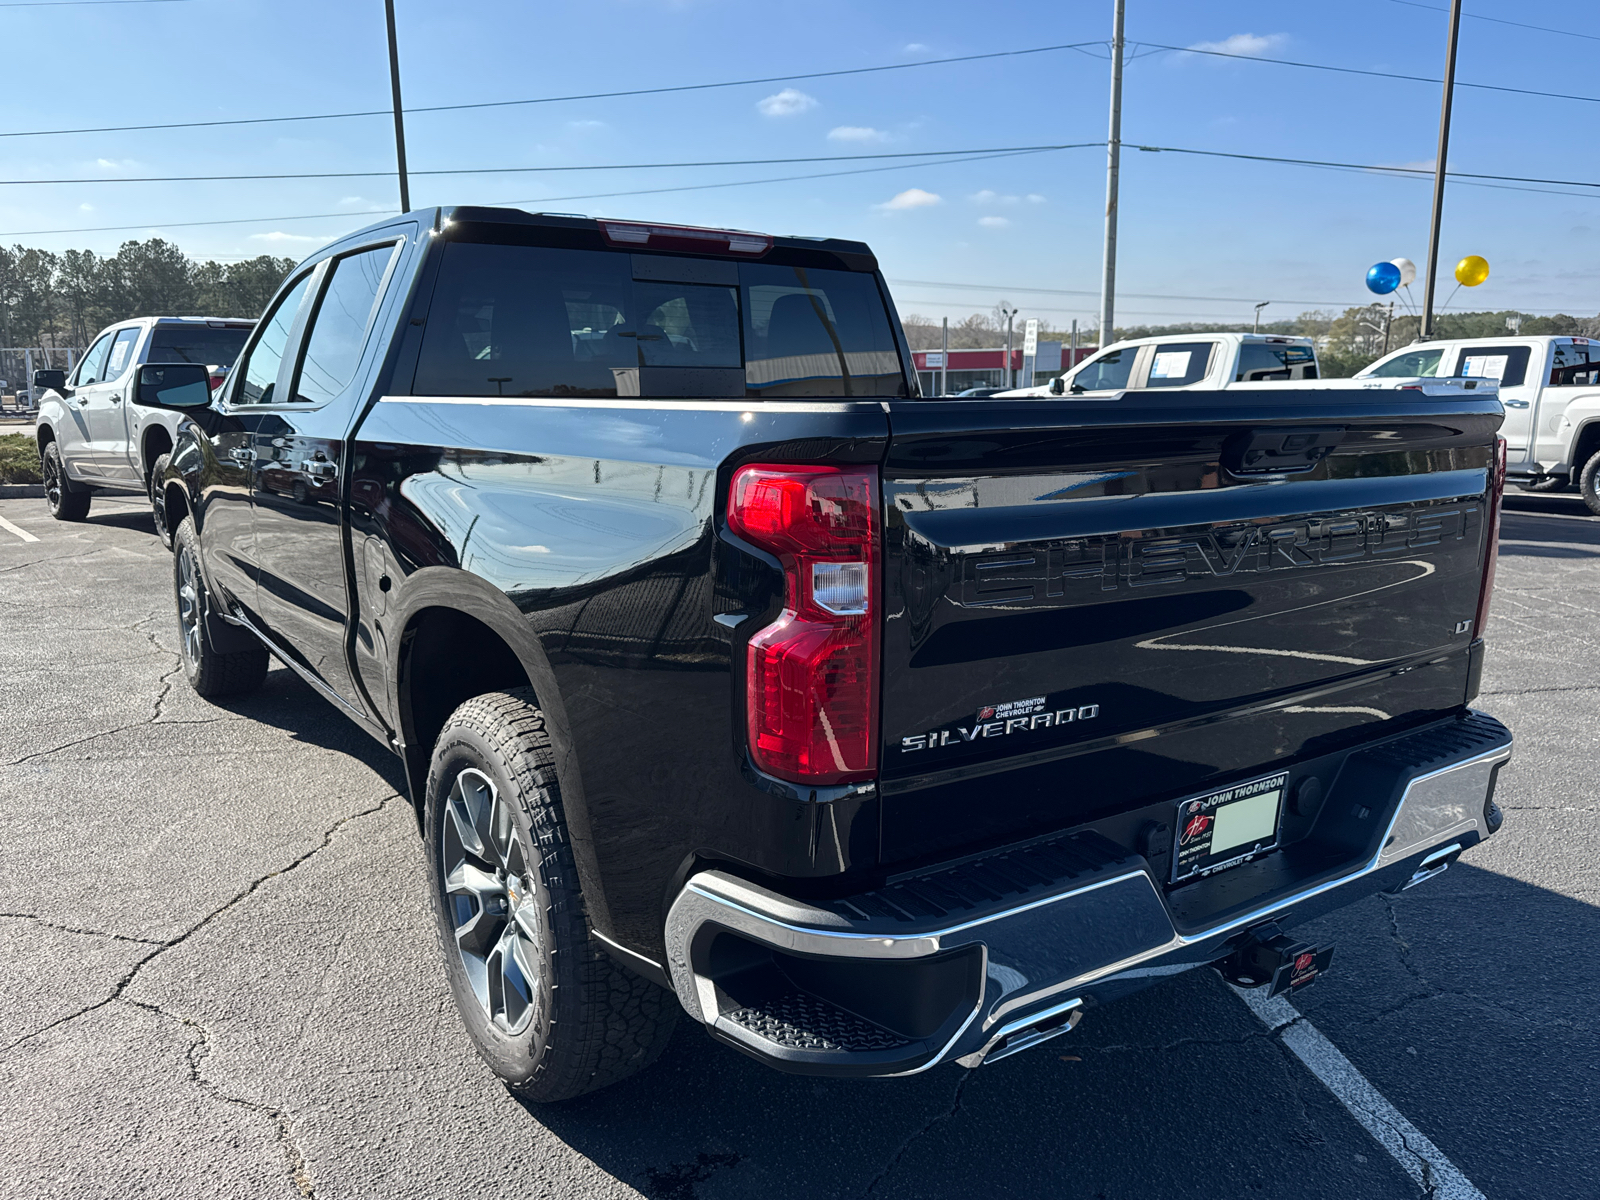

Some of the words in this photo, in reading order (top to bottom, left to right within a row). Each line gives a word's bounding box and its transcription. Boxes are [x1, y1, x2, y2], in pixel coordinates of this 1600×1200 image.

[961, 507, 1477, 608] CHEVROLET
[1455, 619, 1472, 634] LT
[996, 702, 1012, 713] JOHN
[1013, 696, 1046, 709] THORNTON
[995, 707, 1033, 719] CHEVROLET
[901, 703, 1100, 753] SILVERADO
[1206, 791, 1233, 806] JOHN
[1234, 776, 1284, 797] THORNTON
[1179, 849, 1189, 857] JOHN
[1189, 842, 1211, 854] THORNTON
[1212, 858, 1244, 873] CHEVROLET
